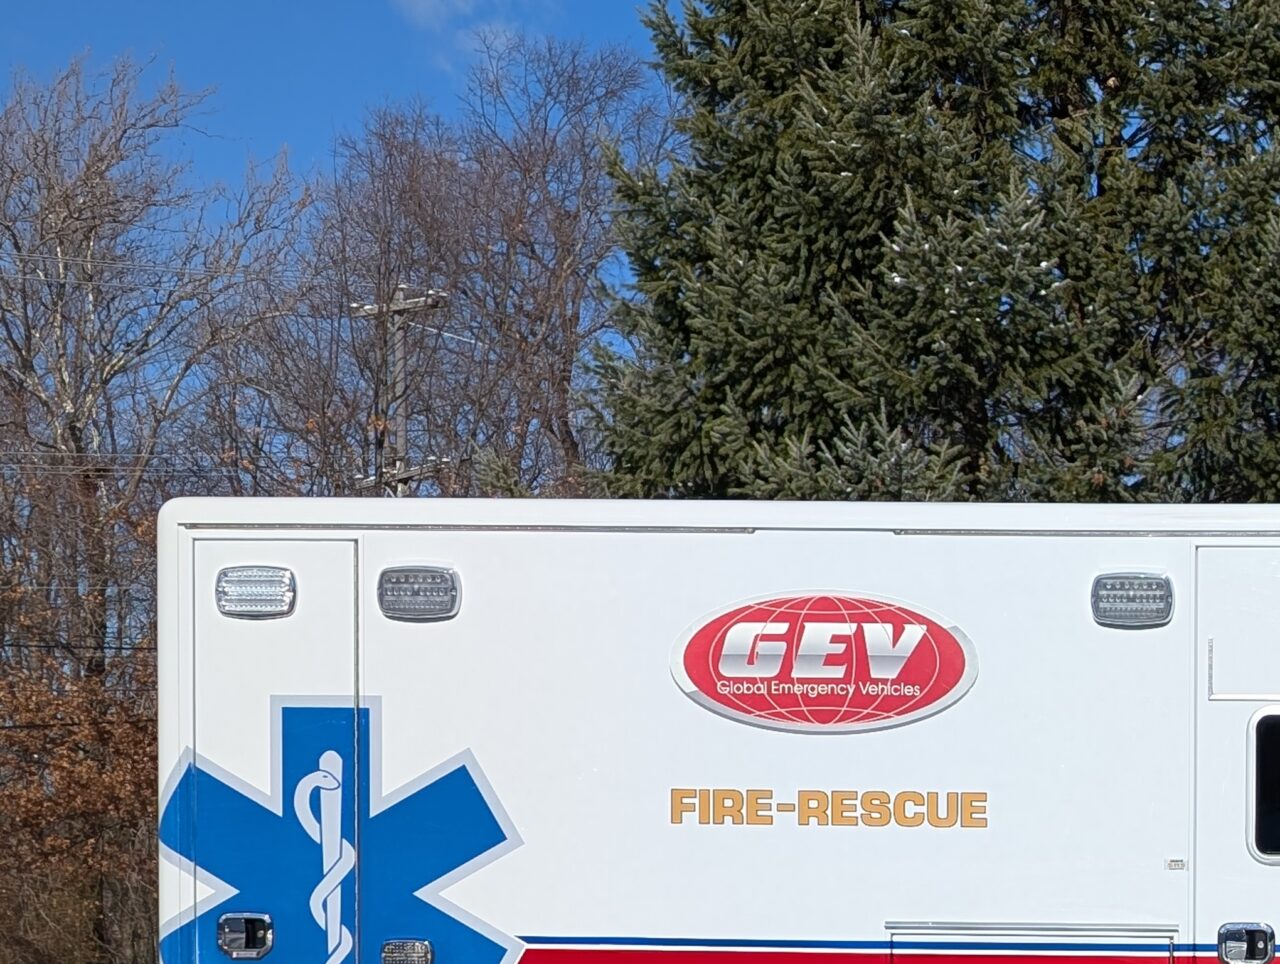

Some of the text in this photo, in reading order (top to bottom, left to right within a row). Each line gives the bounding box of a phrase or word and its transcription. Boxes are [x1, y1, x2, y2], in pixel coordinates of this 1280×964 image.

[717, 621, 927, 679] GEV
[716, 680, 921, 698] Global Emergency Vehicles
[670, 788, 988, 829] FIRE-RESCUE
